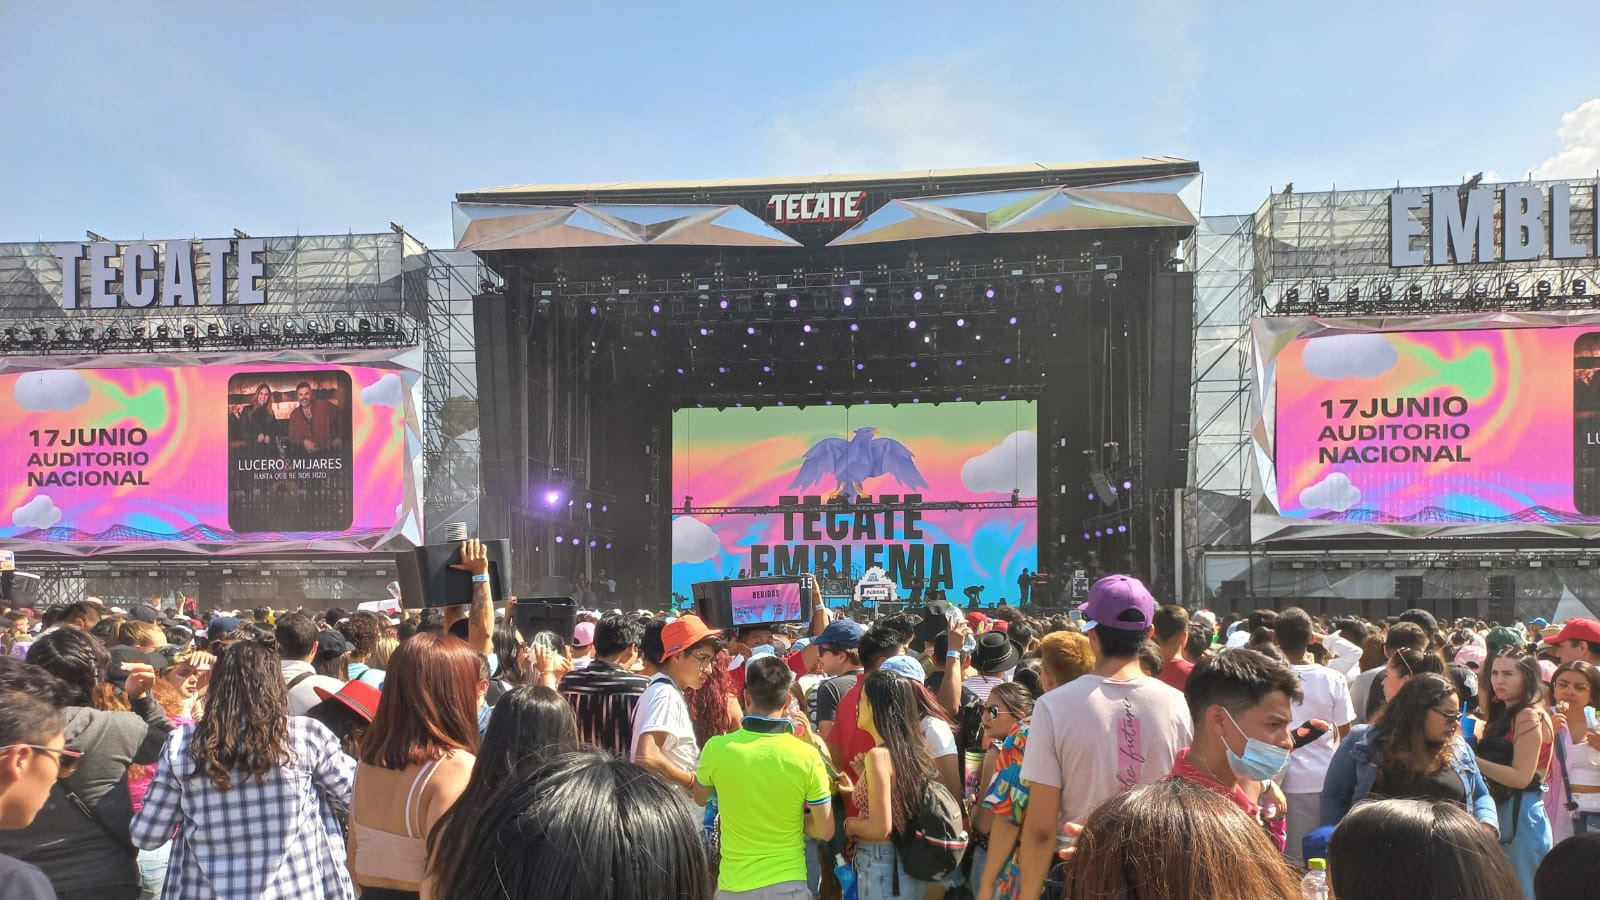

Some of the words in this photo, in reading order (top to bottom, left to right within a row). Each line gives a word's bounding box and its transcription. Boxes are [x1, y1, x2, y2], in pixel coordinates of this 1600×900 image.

[766, 191, 867, 224] TECATE
[1389, 183, 1600, 268] EMBL
[55, 239, 267, 310] TECATE
[1317, 423, 1470, 442] AUDITORIO
[27, 451, 149, 467] AUDITORIO
[1319, 445, 1471, 464] NACIONAL
[28, 470, 150, 487] NACIONAL
[254, 472, 273, 480] HASTA
[274, 472, 287, 480] QUE
[289, 472, 297, 480] SE
[312, 471, 327, 479] HIZO
[778, 494, 923, 541] TECATE
[801, 577, 813, 589] 15
[1119, 696, 1146, 763] future
